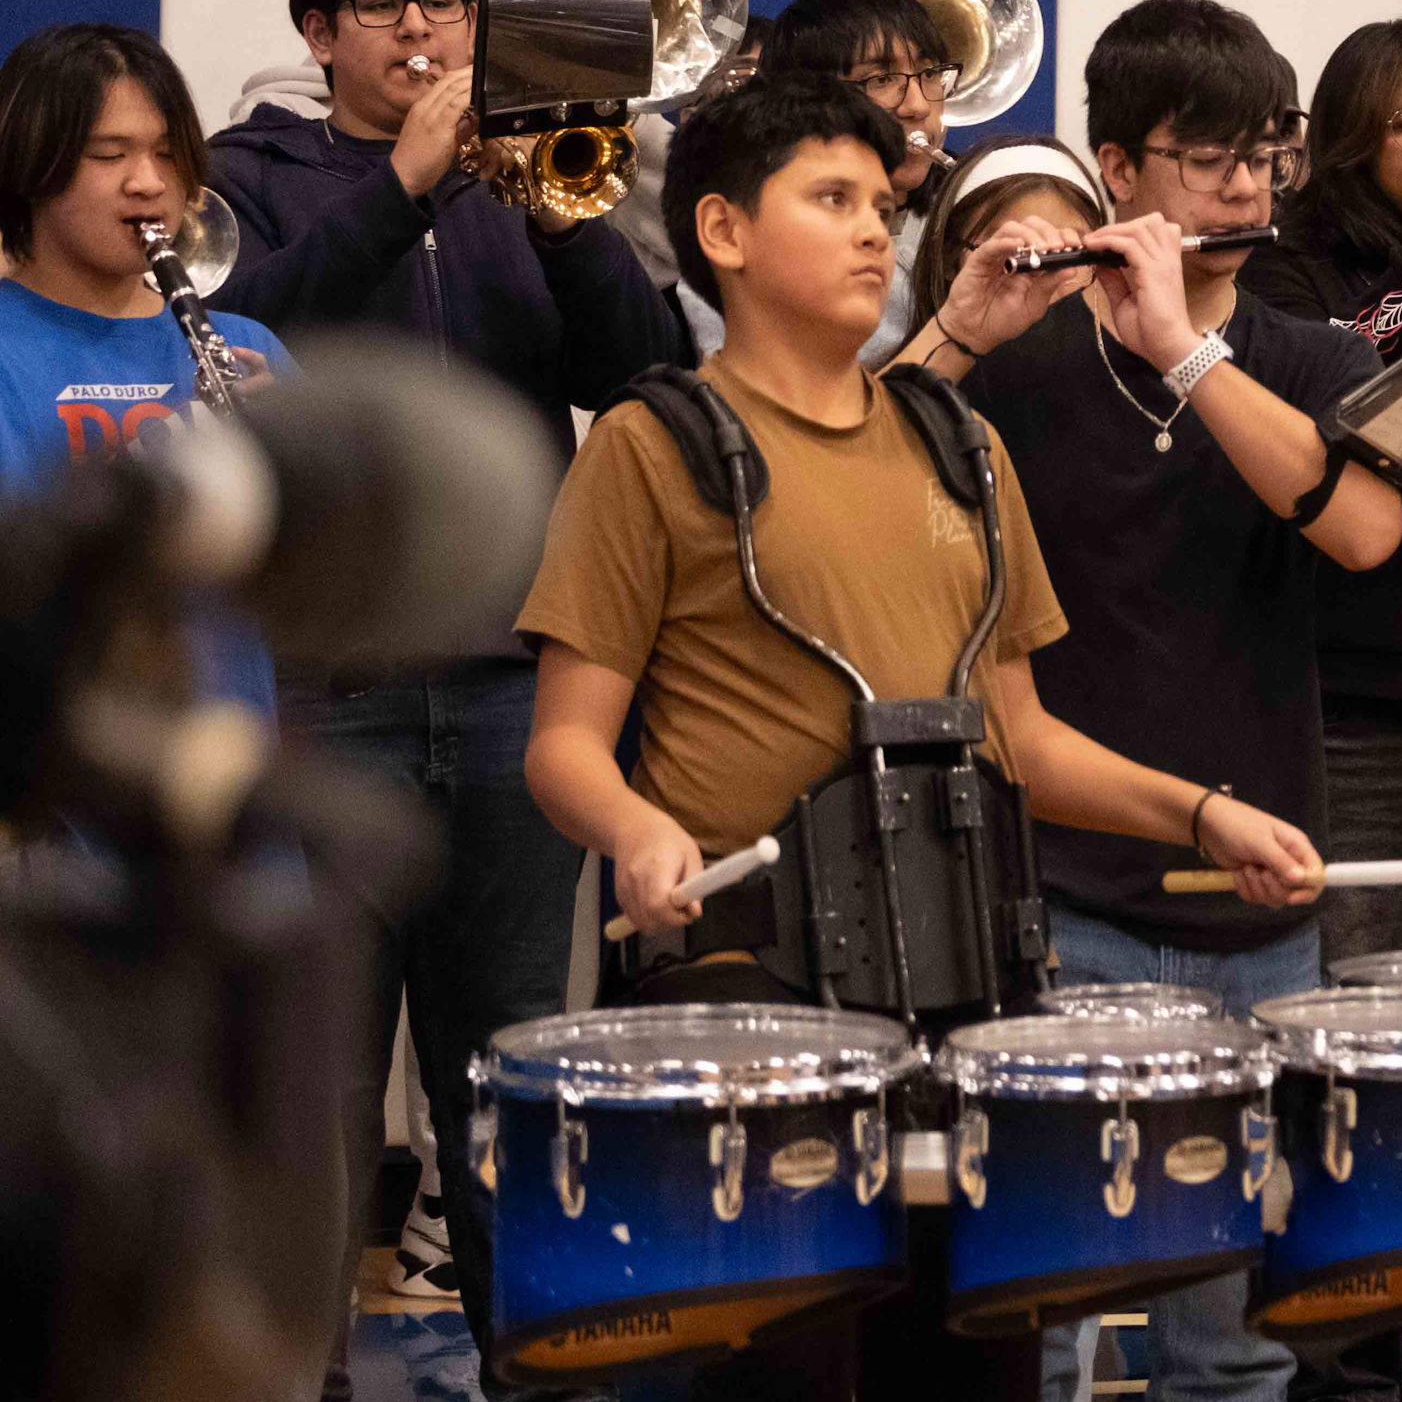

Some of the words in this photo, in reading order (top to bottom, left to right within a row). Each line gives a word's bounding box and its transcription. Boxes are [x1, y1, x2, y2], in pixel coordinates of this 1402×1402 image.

[71, 386, 110, 397] PALO
[115, 386, 159, 398] DURO
[575, 1308, 672, 1344] YAMAHA
